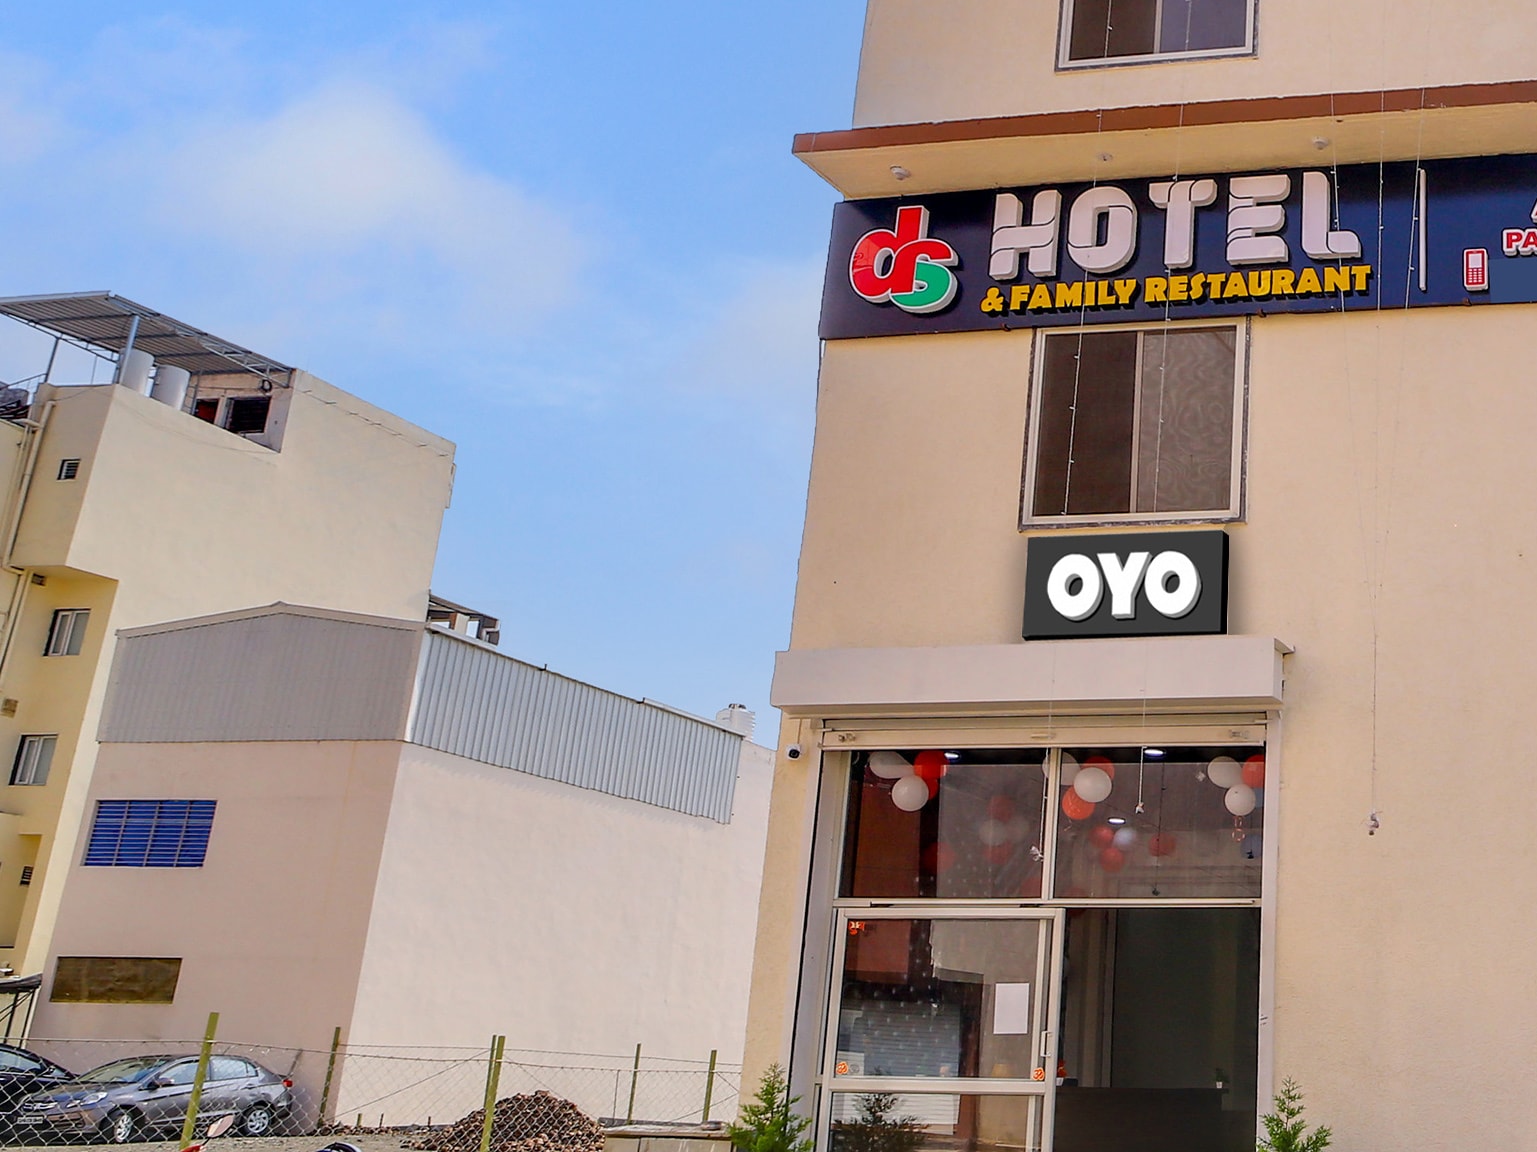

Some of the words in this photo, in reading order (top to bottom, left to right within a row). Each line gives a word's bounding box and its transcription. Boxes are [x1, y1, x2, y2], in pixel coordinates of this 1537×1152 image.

[989, 171, 1362, 280] HOTEL
[981, 286, 1005, 313] &
[1010, 278, 1137, 312] FAMILY
[1144, 264, 1373, 304] RESTAURANT
[1047, 550, 1202, 622] OYO
